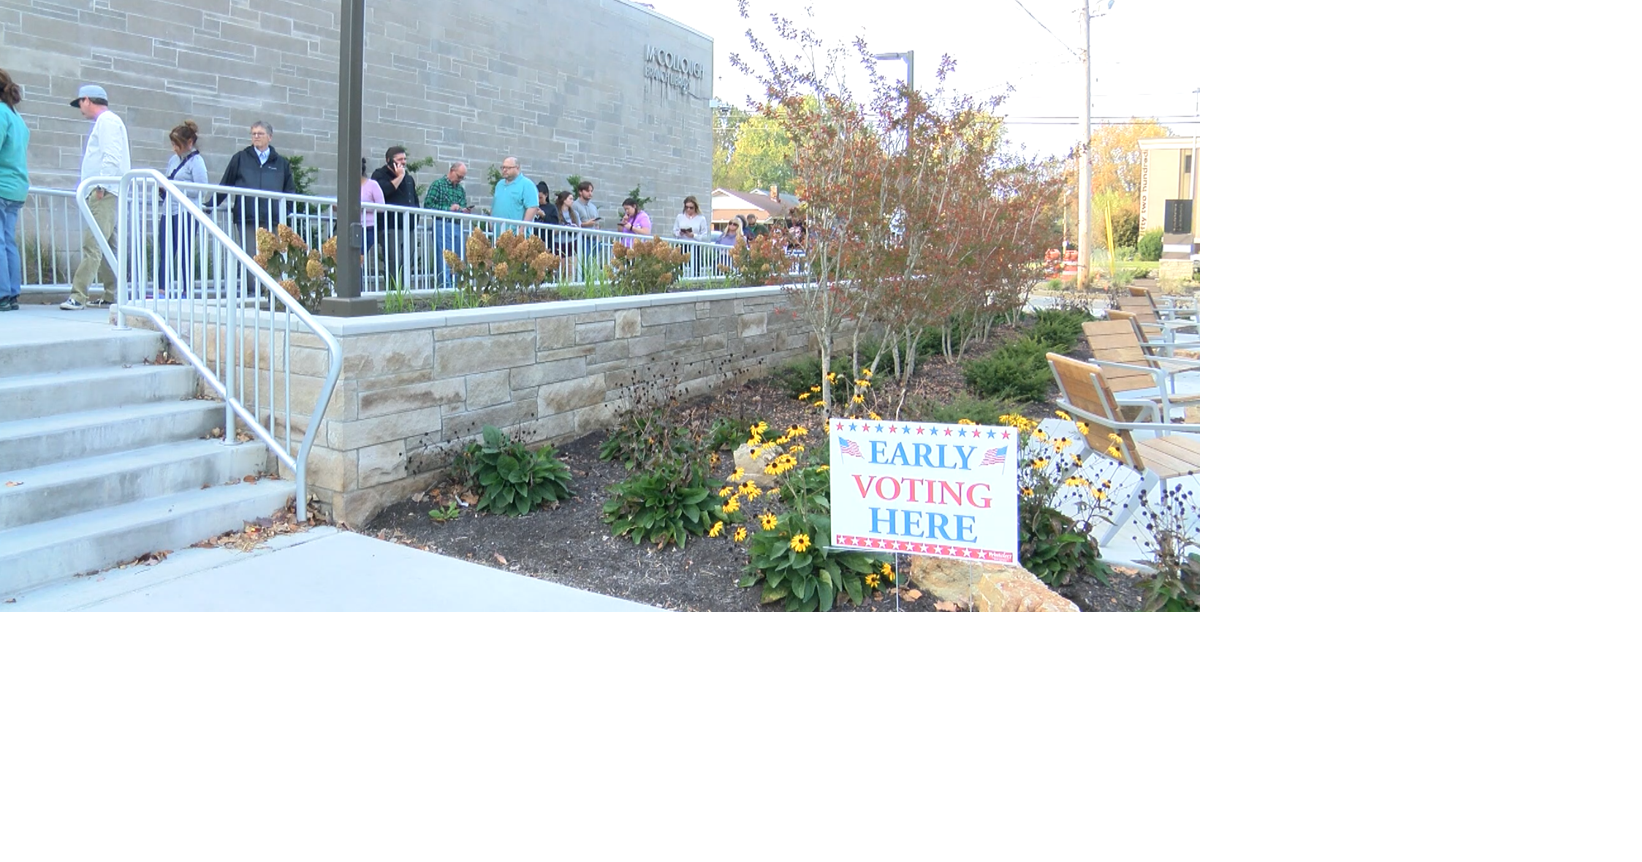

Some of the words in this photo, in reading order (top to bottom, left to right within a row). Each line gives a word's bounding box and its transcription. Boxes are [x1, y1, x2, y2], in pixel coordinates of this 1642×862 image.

[868, 440, 978, 470] EARLY
[851, 474, 993, 508] VOTING
[868, 507, 978, 543] HERE
